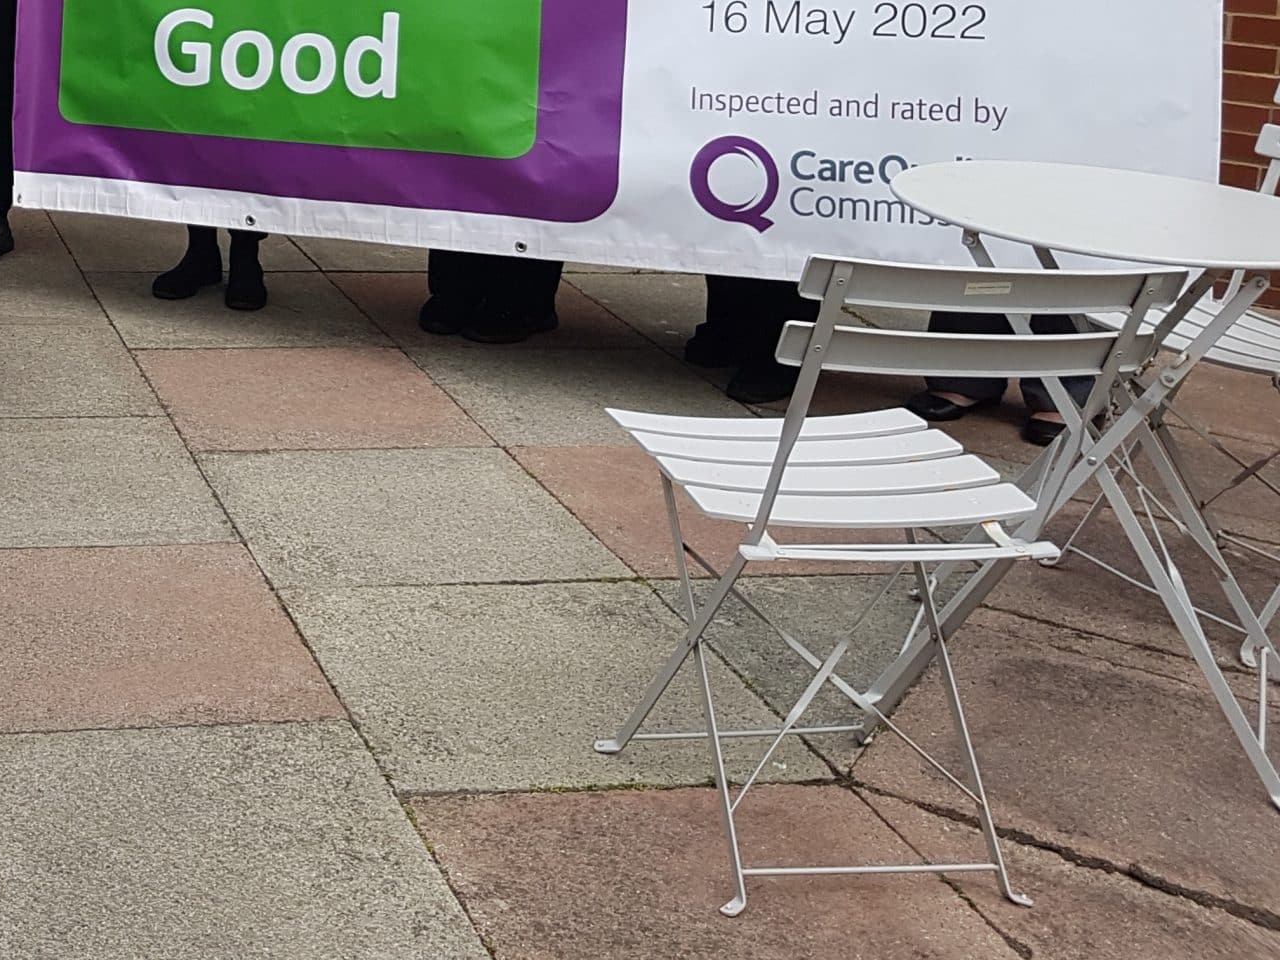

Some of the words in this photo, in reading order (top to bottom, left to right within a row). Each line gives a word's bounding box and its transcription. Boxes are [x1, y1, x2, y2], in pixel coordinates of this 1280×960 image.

[702, 0, 748, 34] 16
[765, 0, 856, 45] May
[872, 2, 986, 40] 2022
[154, 8, 400, 99] Good
[691, 86, 818, 117] Inspected
[829, 92, 879, 119] and
[891, 96, 961, 122] rated
[974, 97, 1008, 131] by
